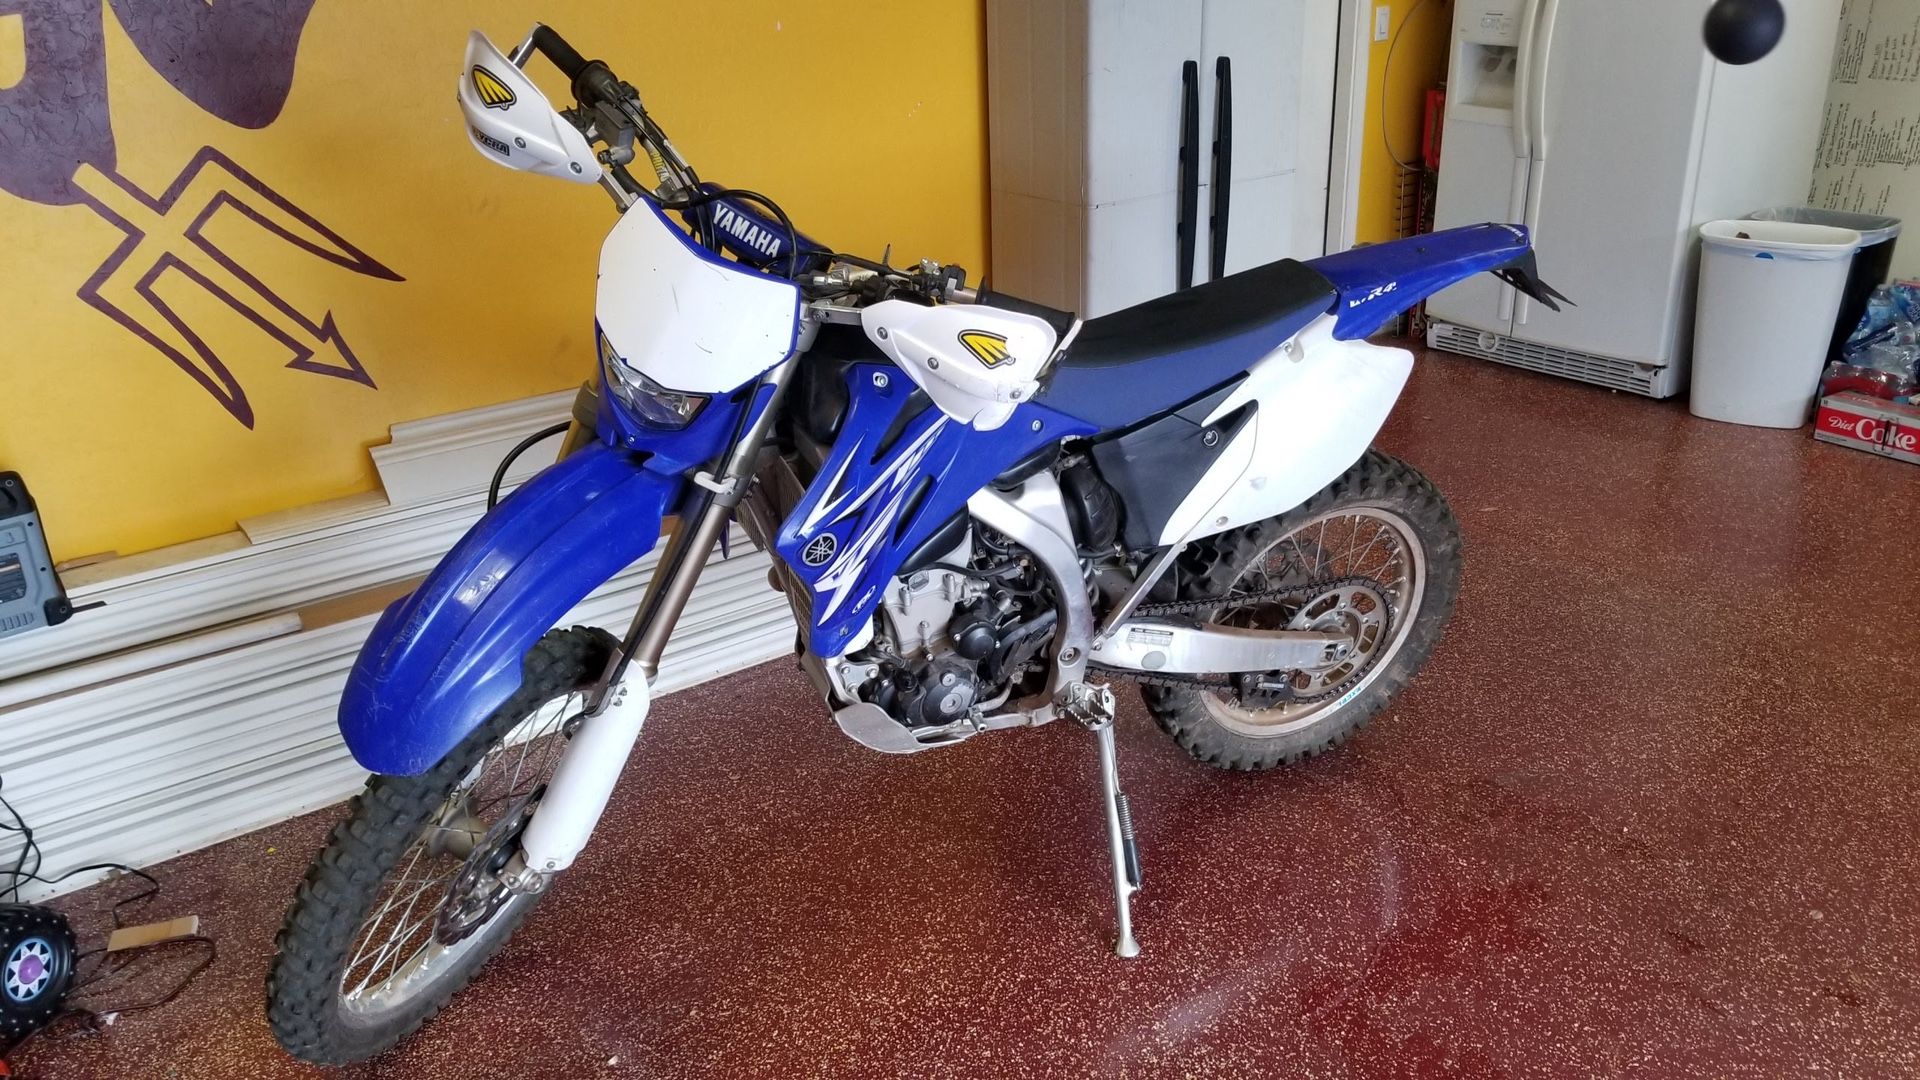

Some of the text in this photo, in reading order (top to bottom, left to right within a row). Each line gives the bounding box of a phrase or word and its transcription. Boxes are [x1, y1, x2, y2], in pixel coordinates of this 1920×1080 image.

[713, 203, 781, 258] YAMAHA
[1828, 415, 1855, 431] Diet
[1855, 418, 1917, 451] Coke
